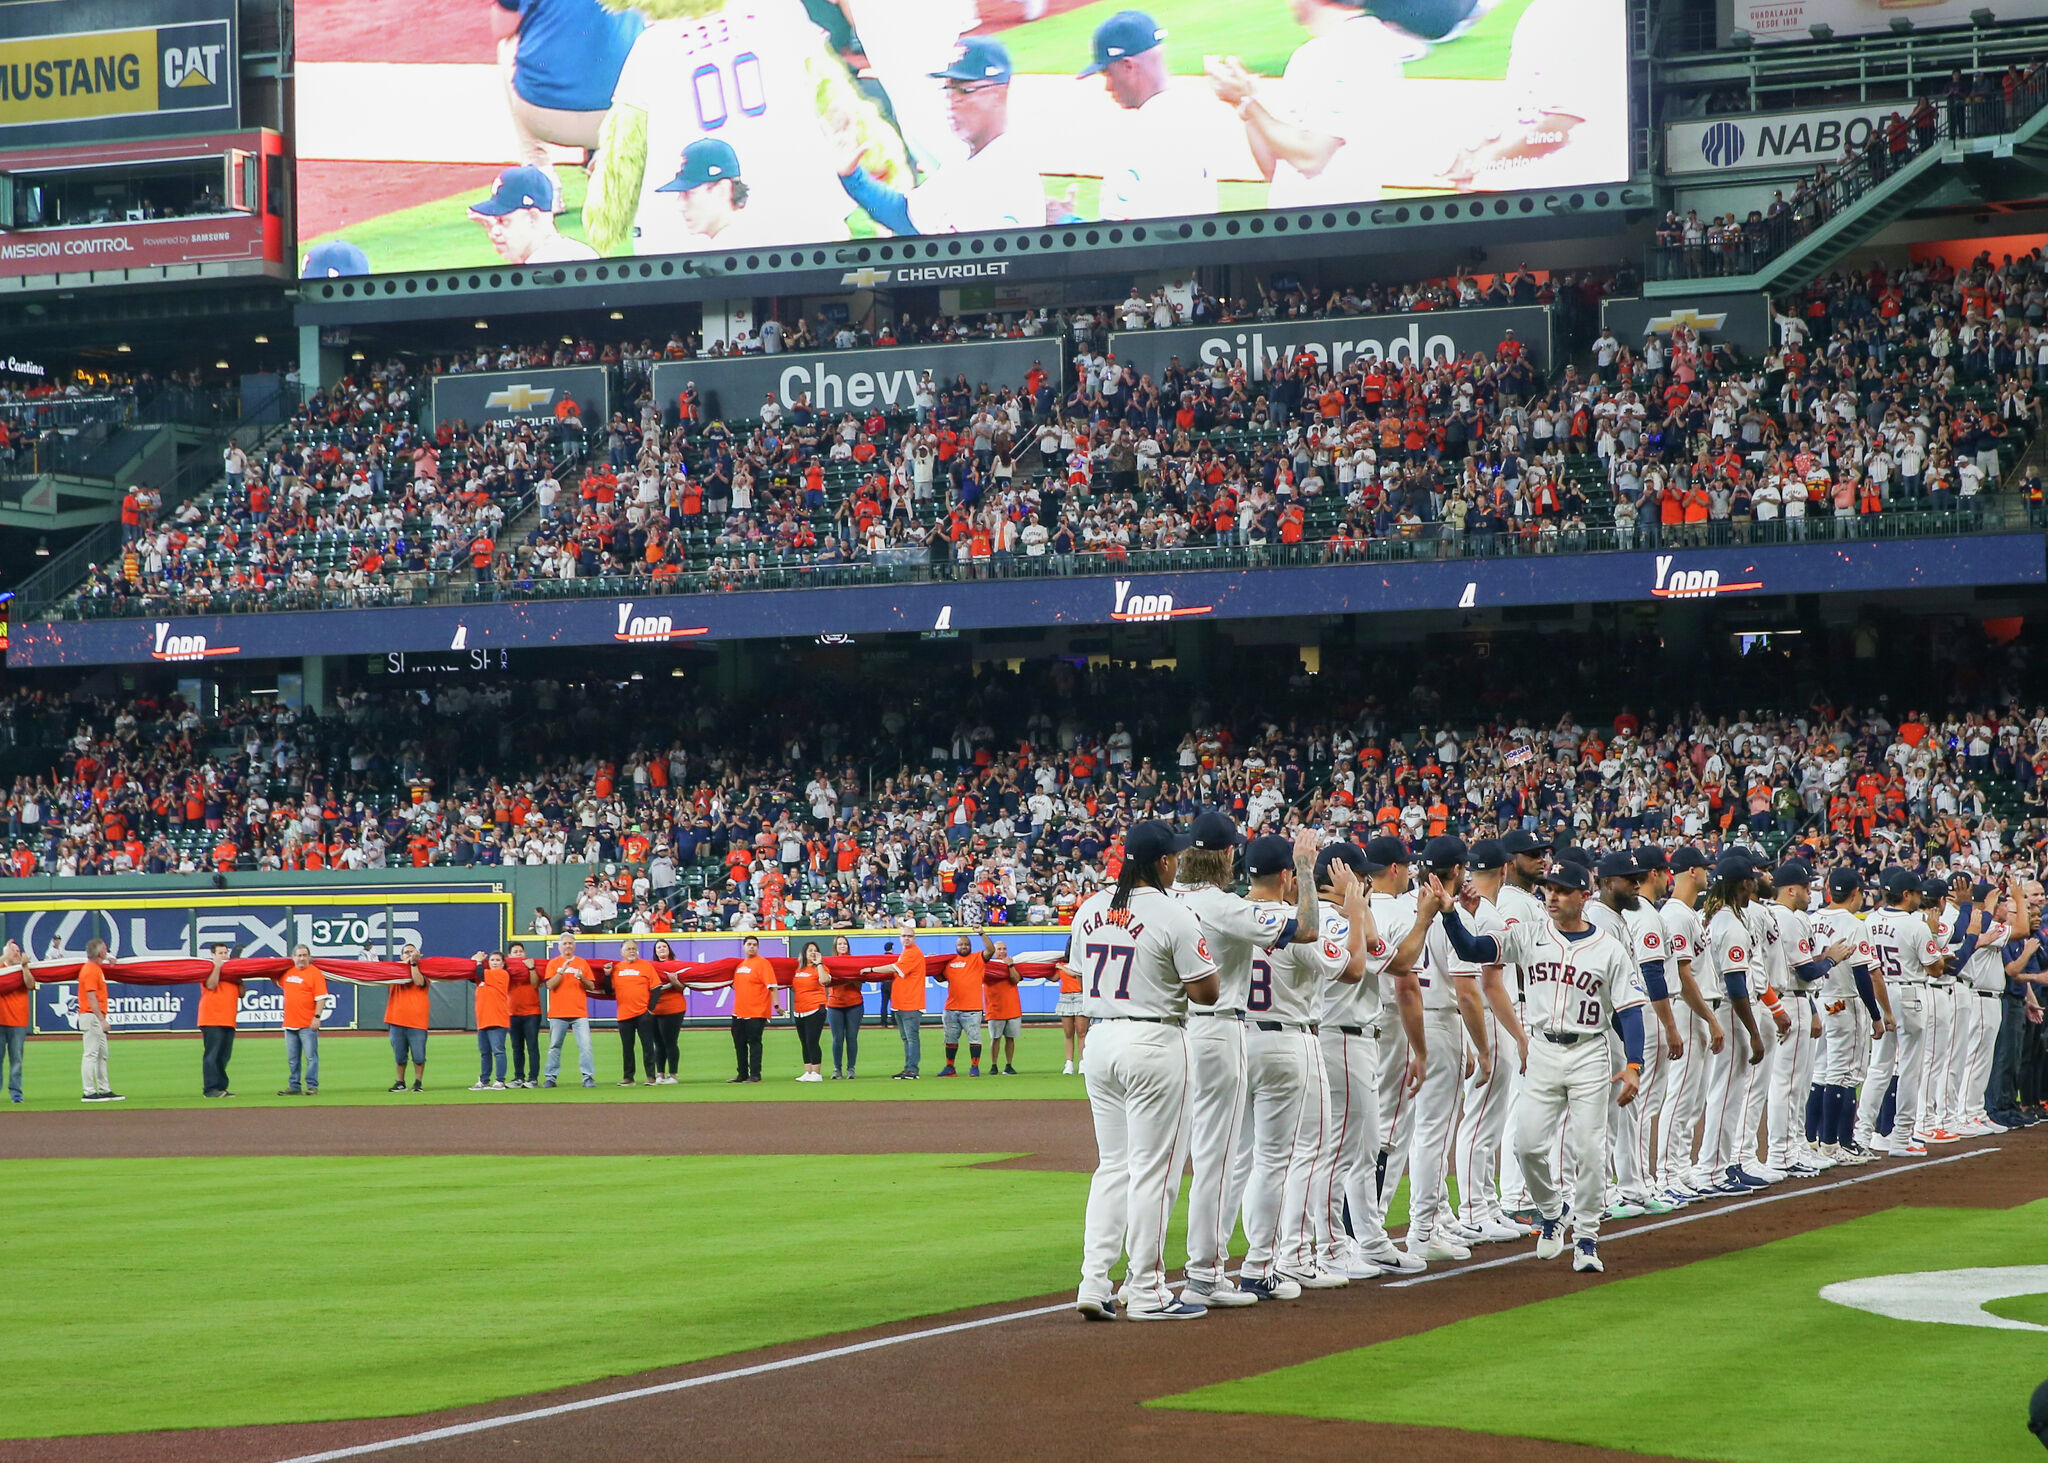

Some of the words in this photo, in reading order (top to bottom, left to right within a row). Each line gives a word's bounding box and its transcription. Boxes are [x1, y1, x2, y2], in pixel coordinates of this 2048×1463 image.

[1750, 7, 1804, 20] GUADALAJARA
[1757, 19, 1779, 29] DESDE
[164, 45, 221, 88] CAT
[1526, 131, 1563, 144] Since
[1, 241, 61, 260] MISSION
[64, 237, 134, 255] CONTROL
[143, 235, 179, 246] Powered
[179, 236, 189, 245] by
[191, 232, 230, 243] SAMSUNG
[897, 262, 1009, 281] CHEVROLET
[1199, 323, 1456, 381] Silverado
[8, 356, 45, 376] Cantina
[779, 362, 934, 411] Chevy
[131, 911, 423, 958] LEXUS
[312, 920, 369, 943] 370
[1082, 911, 1145, 940] GAIA
[1871, 924, 1895, 938] BELL
[1086, 943, 1136, 1000] 77
[1528, 962, 1603, 997] ASTROS
[107, 991, 181, 1012] ermania
[1576, 1000, 1600, 1026] 19
[109, 1013, 165, 1023] SURANCE
